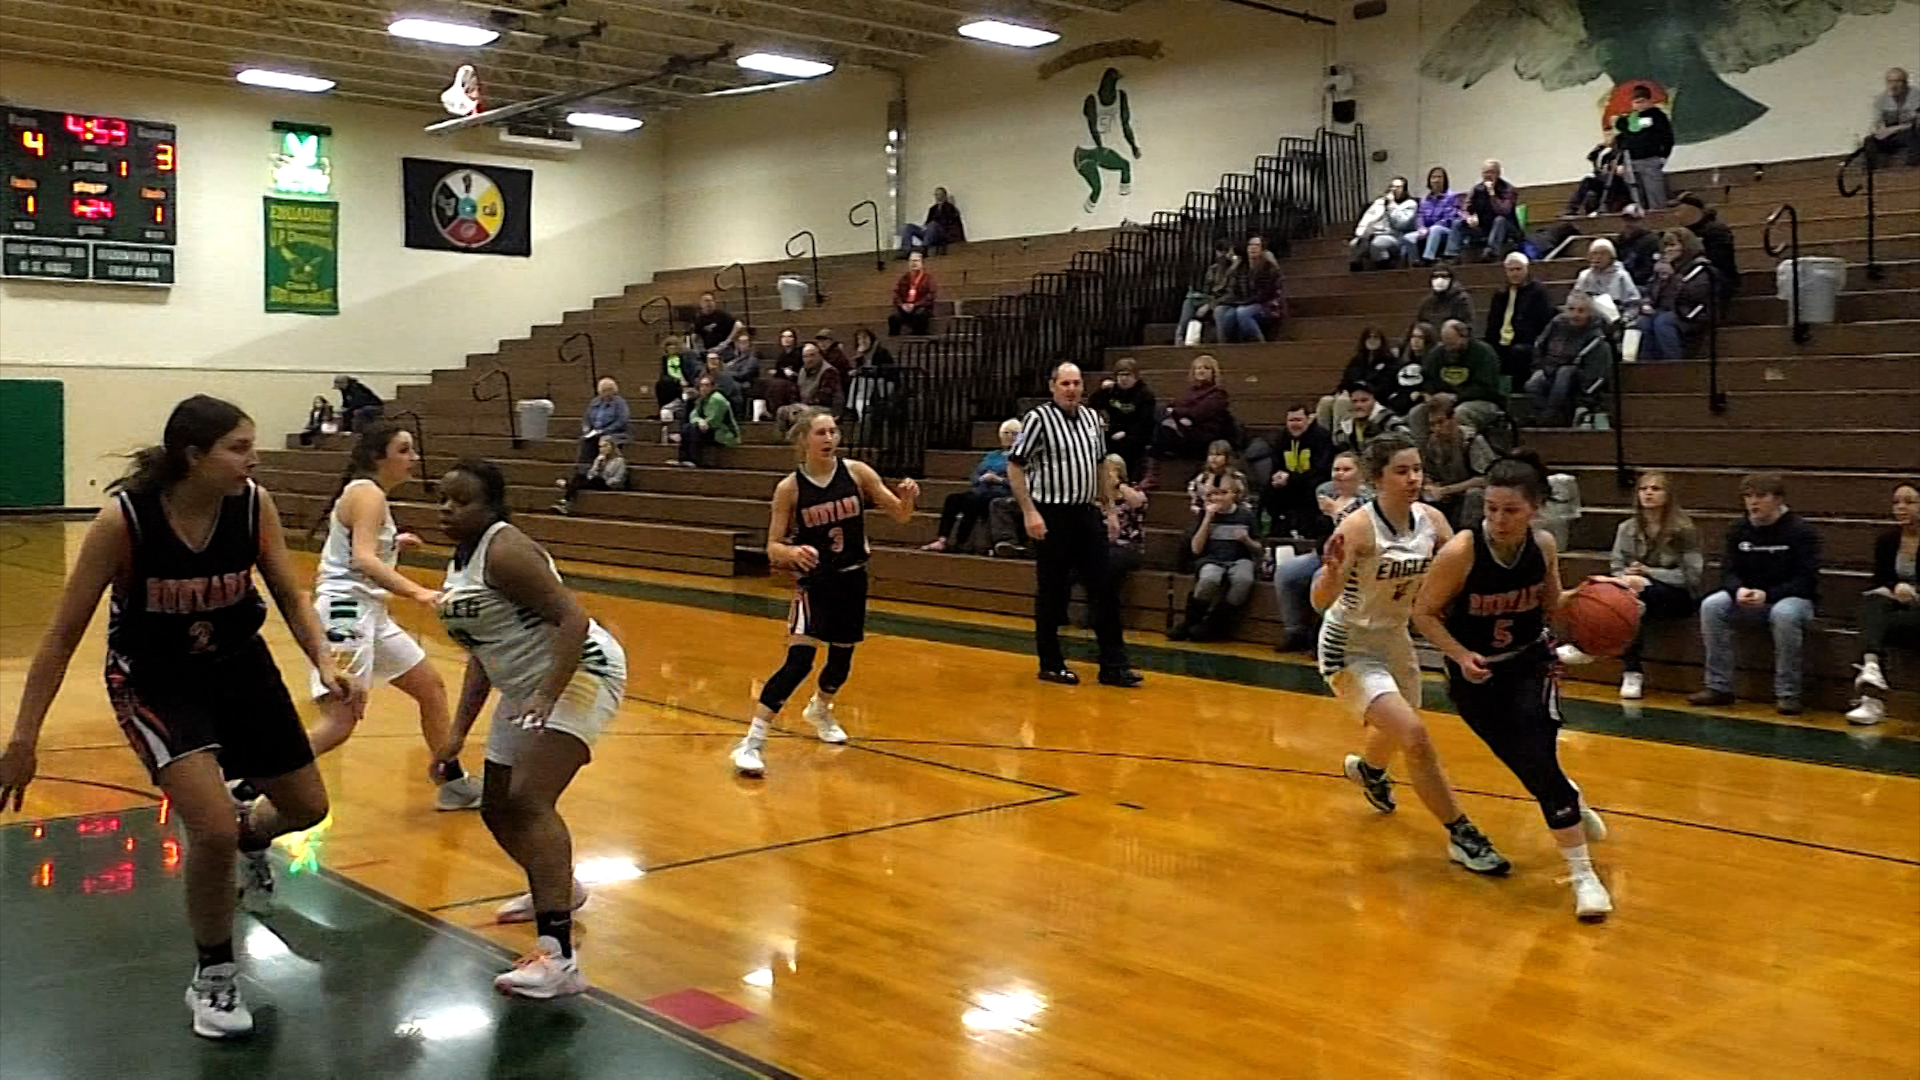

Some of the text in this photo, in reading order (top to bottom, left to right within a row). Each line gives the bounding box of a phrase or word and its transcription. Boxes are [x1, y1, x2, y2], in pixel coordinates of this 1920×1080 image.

[22, 130, 45, 157] 4
[66, 114, 128, 147] 4:53
[119, 160, 128, 177] 1
[155, 143, 174, 171] 3
[26, 194, 36, 213] 1
[154, 205, 164, 223] 1
[828, 527, 844, 552] 3
[1376, 558, 1432, 580] EAGLE
[188, 620, 217, 655] 2
[1490, 619, 1514, 648] 5
